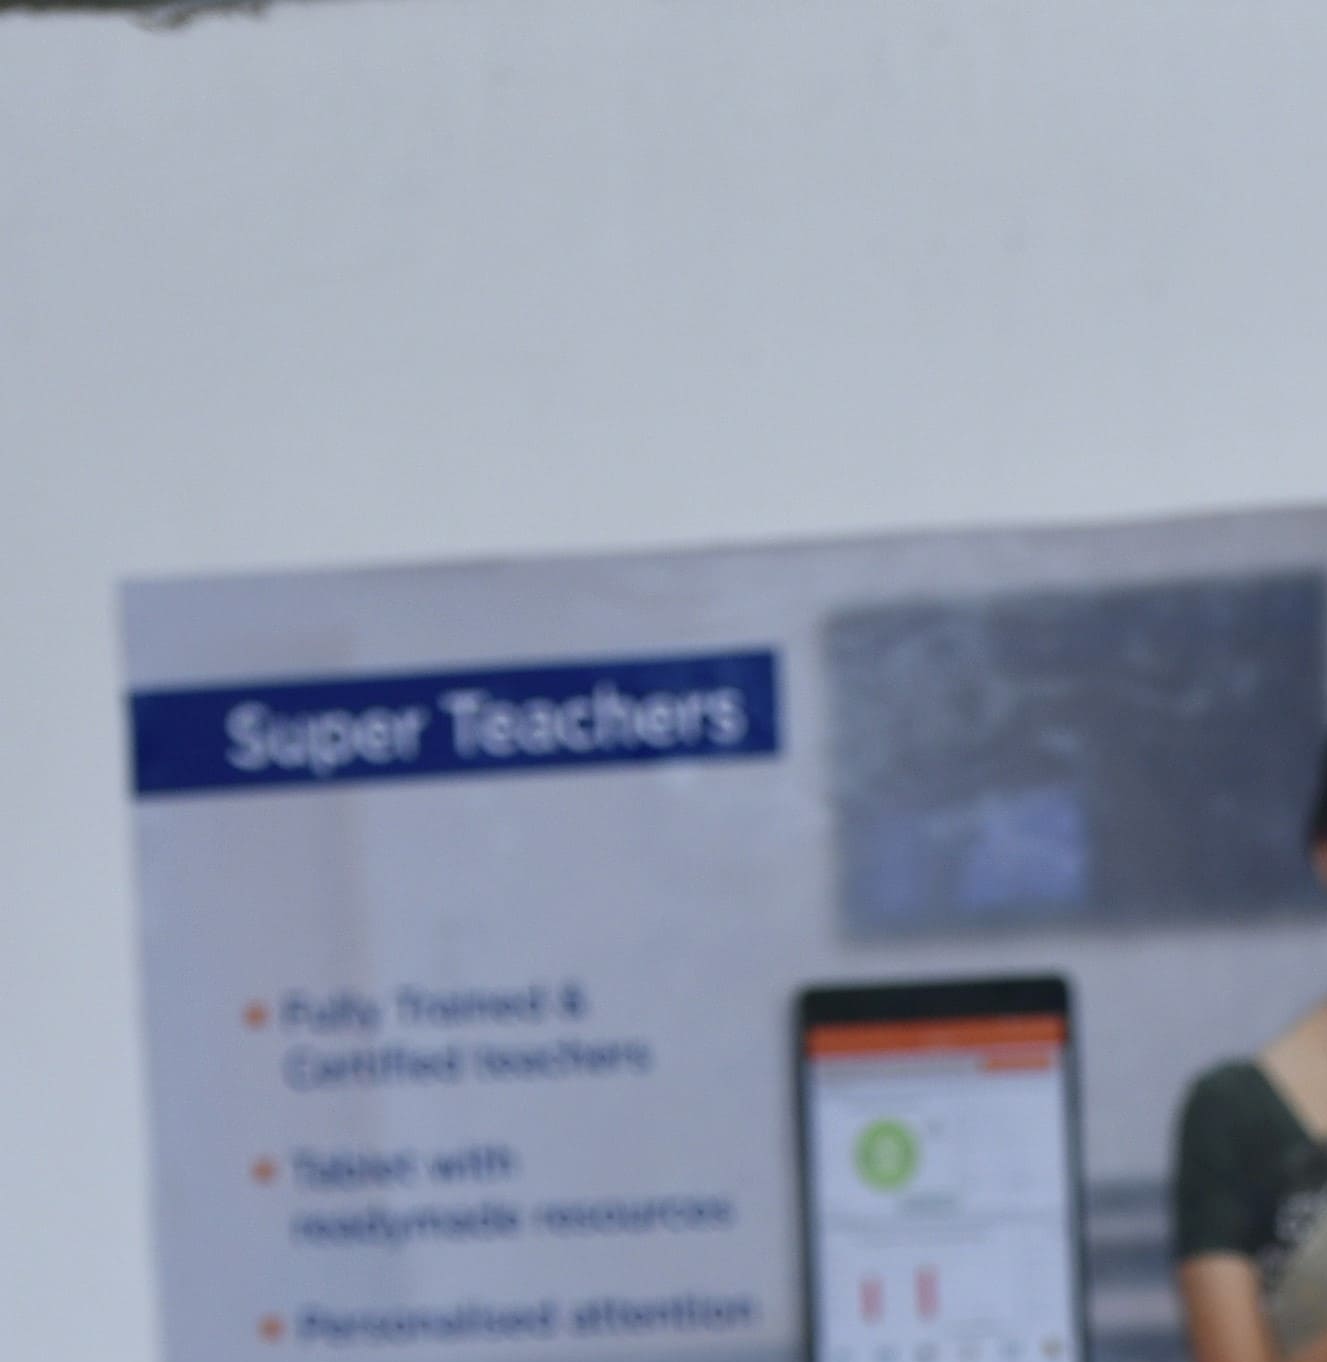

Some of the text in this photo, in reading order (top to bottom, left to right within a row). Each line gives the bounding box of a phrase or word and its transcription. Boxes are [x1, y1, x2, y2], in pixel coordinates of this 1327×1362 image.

[225, 686, 747, 777] Super Teachers
[281, 982, 585, 1030] Fully Trained &
[282, 1041, 650, 1091] Certified teachers
[291, 1144, 514, 1189] Tablet with
[292, 1199, 738, 1247] readymade resources
[569, 1295, 753, 1333] attention
